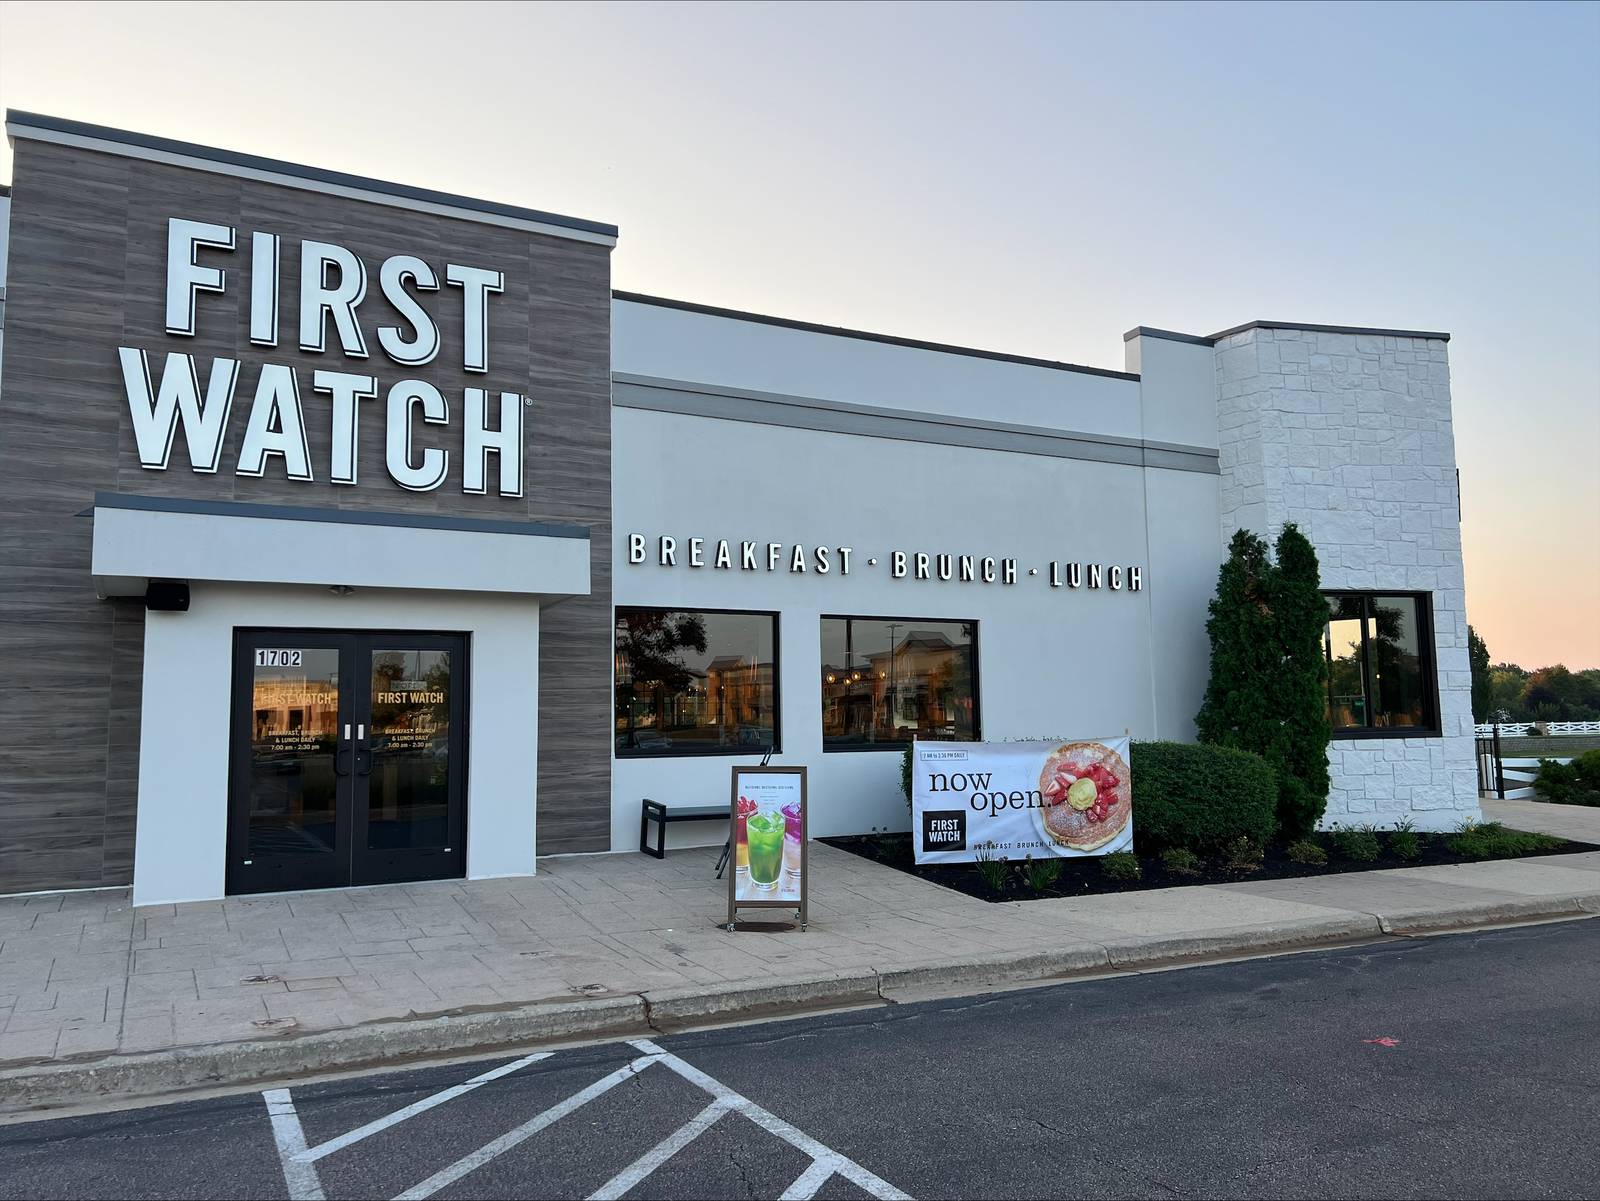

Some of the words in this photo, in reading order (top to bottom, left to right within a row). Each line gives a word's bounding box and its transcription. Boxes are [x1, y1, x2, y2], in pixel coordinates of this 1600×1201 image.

[165, 216, 505, 374] FIRST
[628, 533, 853, 575] BREAKFAST
[891, 551, 1017, 584] BRUNCH
[1050, 561, 1142, 591] LUNCH
[258, 650, 300, 666] 1702
[295, 693, 331, 704] WATCH
[378, 692, 408, 704] FIRST
[410, 692, 444, 704] WATCH
[929, 772, 993, 792] now
[970, 790, 1052, 818] open.
[931, 819, 959, 831] FIRST
[928, 831, 961, 843] WATCH
[1017, 840, 1044, 849] BRUNCH
[1048, 839, 1070, 847] LUNCH
